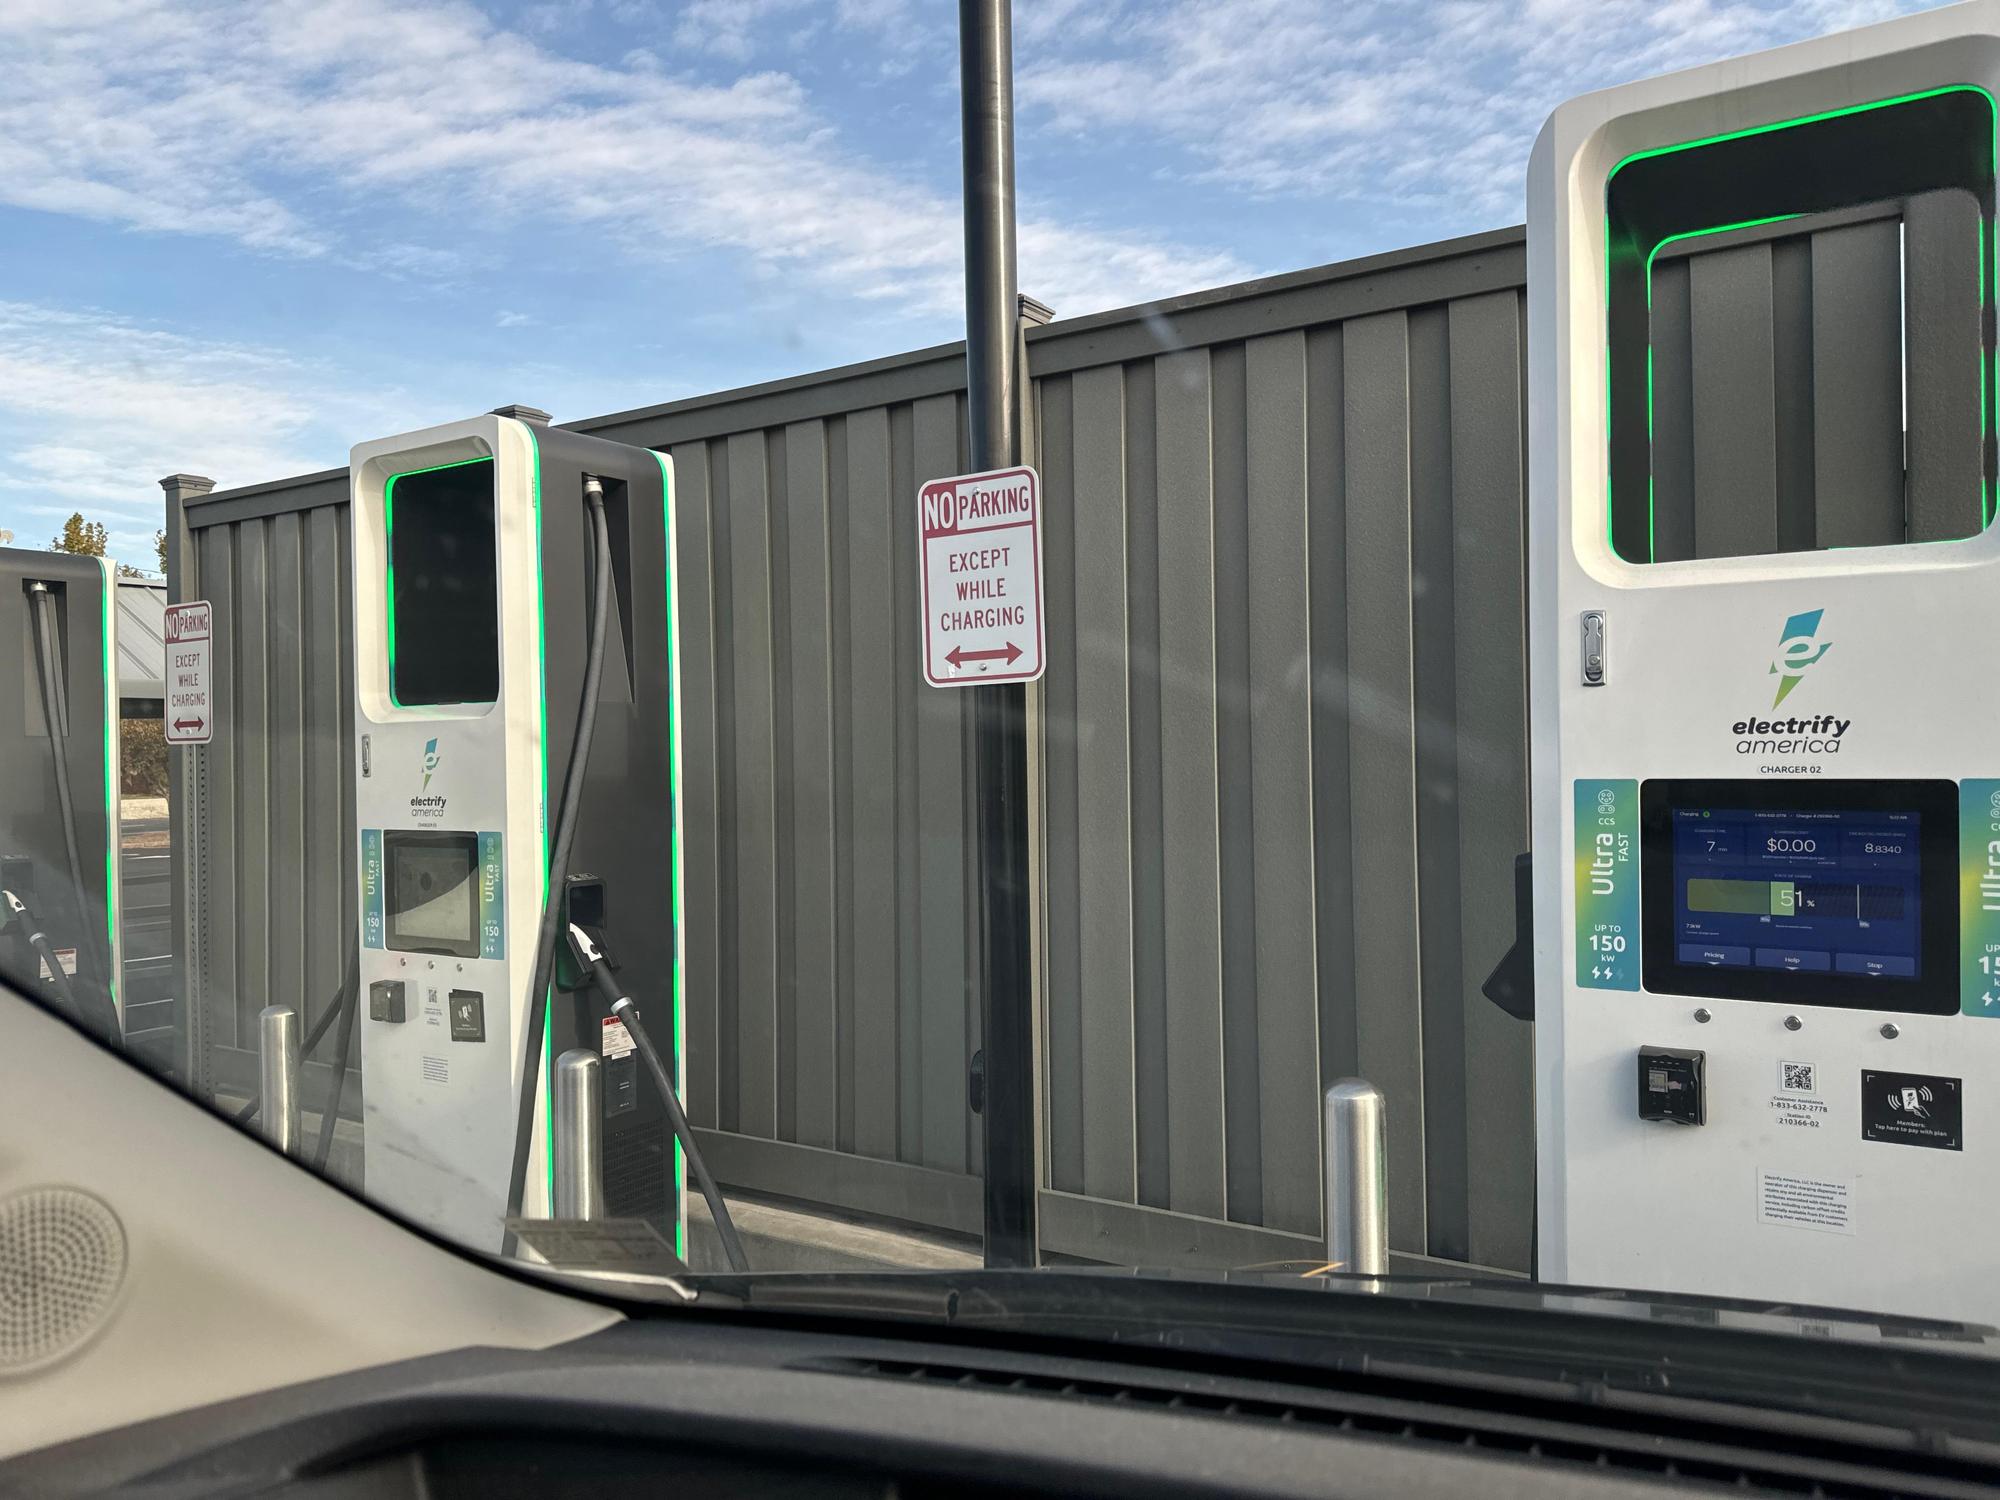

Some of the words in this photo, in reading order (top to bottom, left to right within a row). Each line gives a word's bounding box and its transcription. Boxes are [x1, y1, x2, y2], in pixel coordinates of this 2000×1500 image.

[924, 491, 954, 531] NO
[959, 486, 1029, 520] PARKING
[950, 547, 1010, 573] EXCEPT
[956, 578, 1006, 601] WHILE
[166, 613, 178, 639] NO
[180, 614, 207, 633] PARKING
[941, 605, 1024, 631] CHARGING
[176, 654, 200, 668] EXCEPT
[178, 673, 198, 687] WHILE
[172, 693, 205, 707] CHARGING
[1732, 715, 1851, 738] electrify
[1736, 736, 1840, 754] america
[410, 796, 446, 808] electrify
[412, 808, 444, 817] america
[1619, 832, 1628, 861] FAST
[1707, 841, 1715, 852] 7
[1767, 837, 1816, 853] $0.00
[1590, 833, 1614, 895] Ultra
[367, 860, 375, 895] Ultra
[485, 864, 494, 902] Ultra
[1781, 890, 1802, 907] 51
[367, 918, 379, 927] 150
[1609, 925, 1621, 933] TO
[484, 926, 499, 937] 150
[1589, 935, 1625, 952] 150
[1770, 1102, 1828, 1112] 1-833-632-2778
[1779, 1118, 1820, 1128] 210366-02
